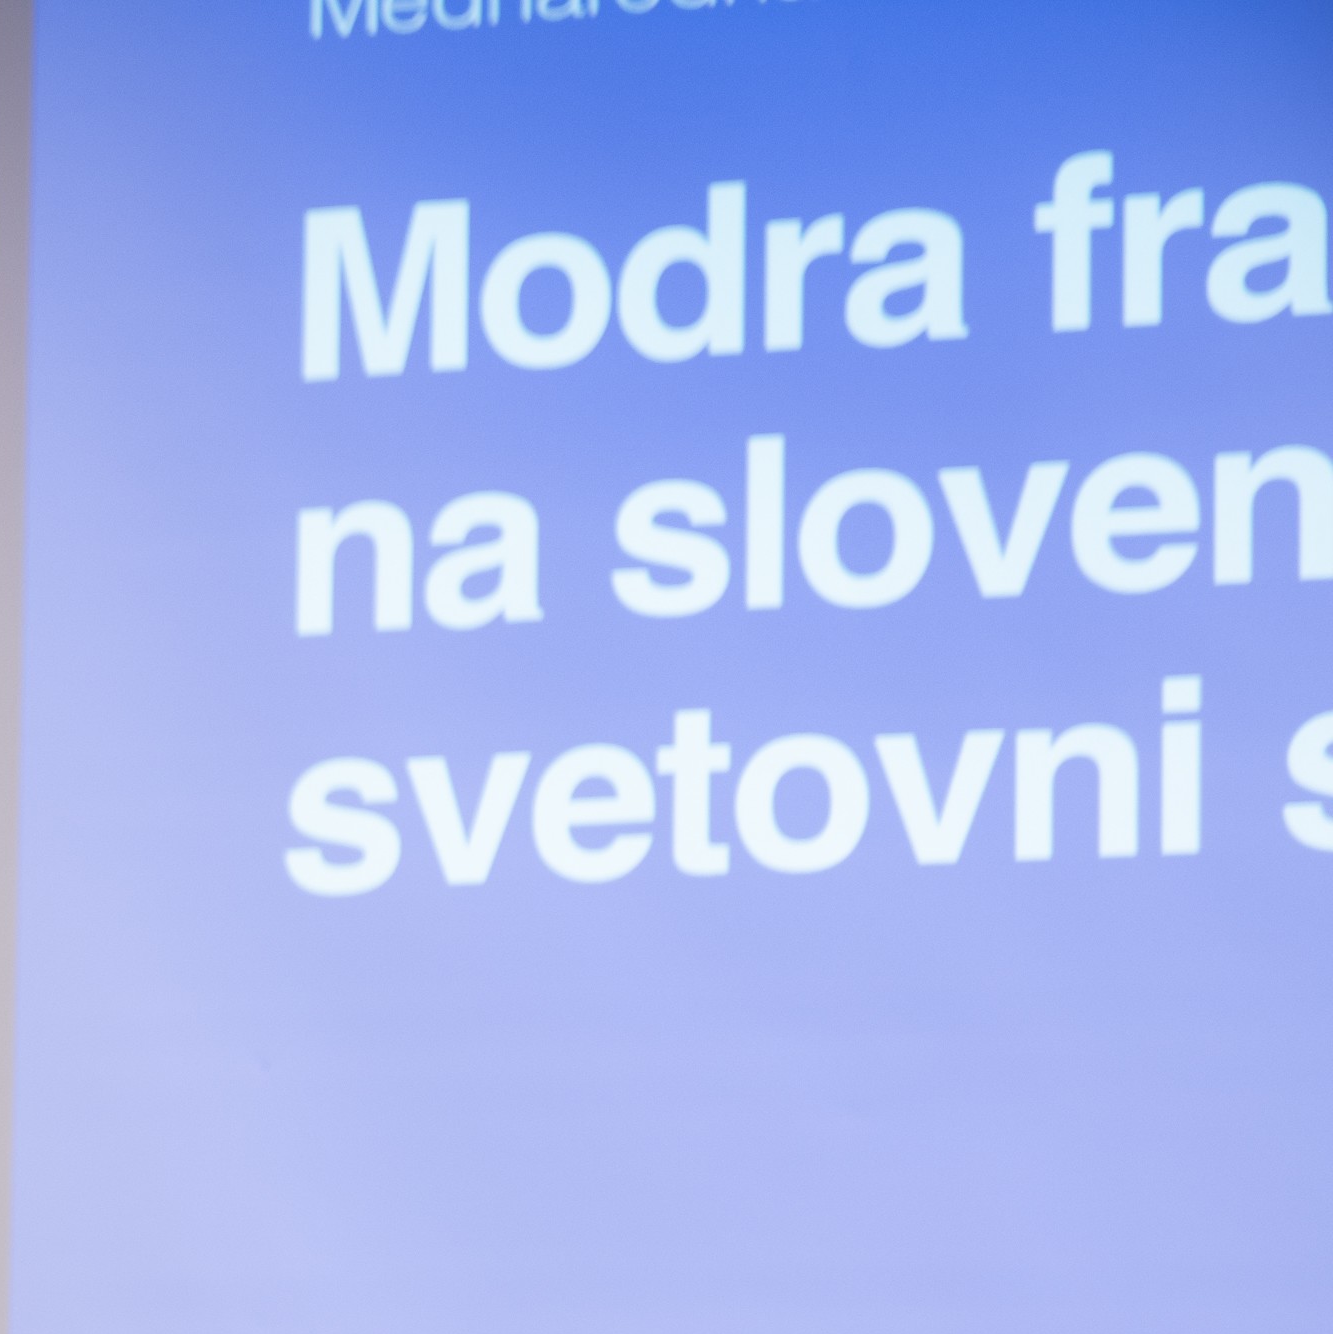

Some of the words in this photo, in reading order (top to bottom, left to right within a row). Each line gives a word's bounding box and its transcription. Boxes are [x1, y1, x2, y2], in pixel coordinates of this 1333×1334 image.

[300, 181, 968, 382] Modra
[1034, 152, 1333, 332] fra
[293, 490, 544, 639] na
[610, 433, 1333, 619] sloven
[281, 674, 1203, 899] svetovni
